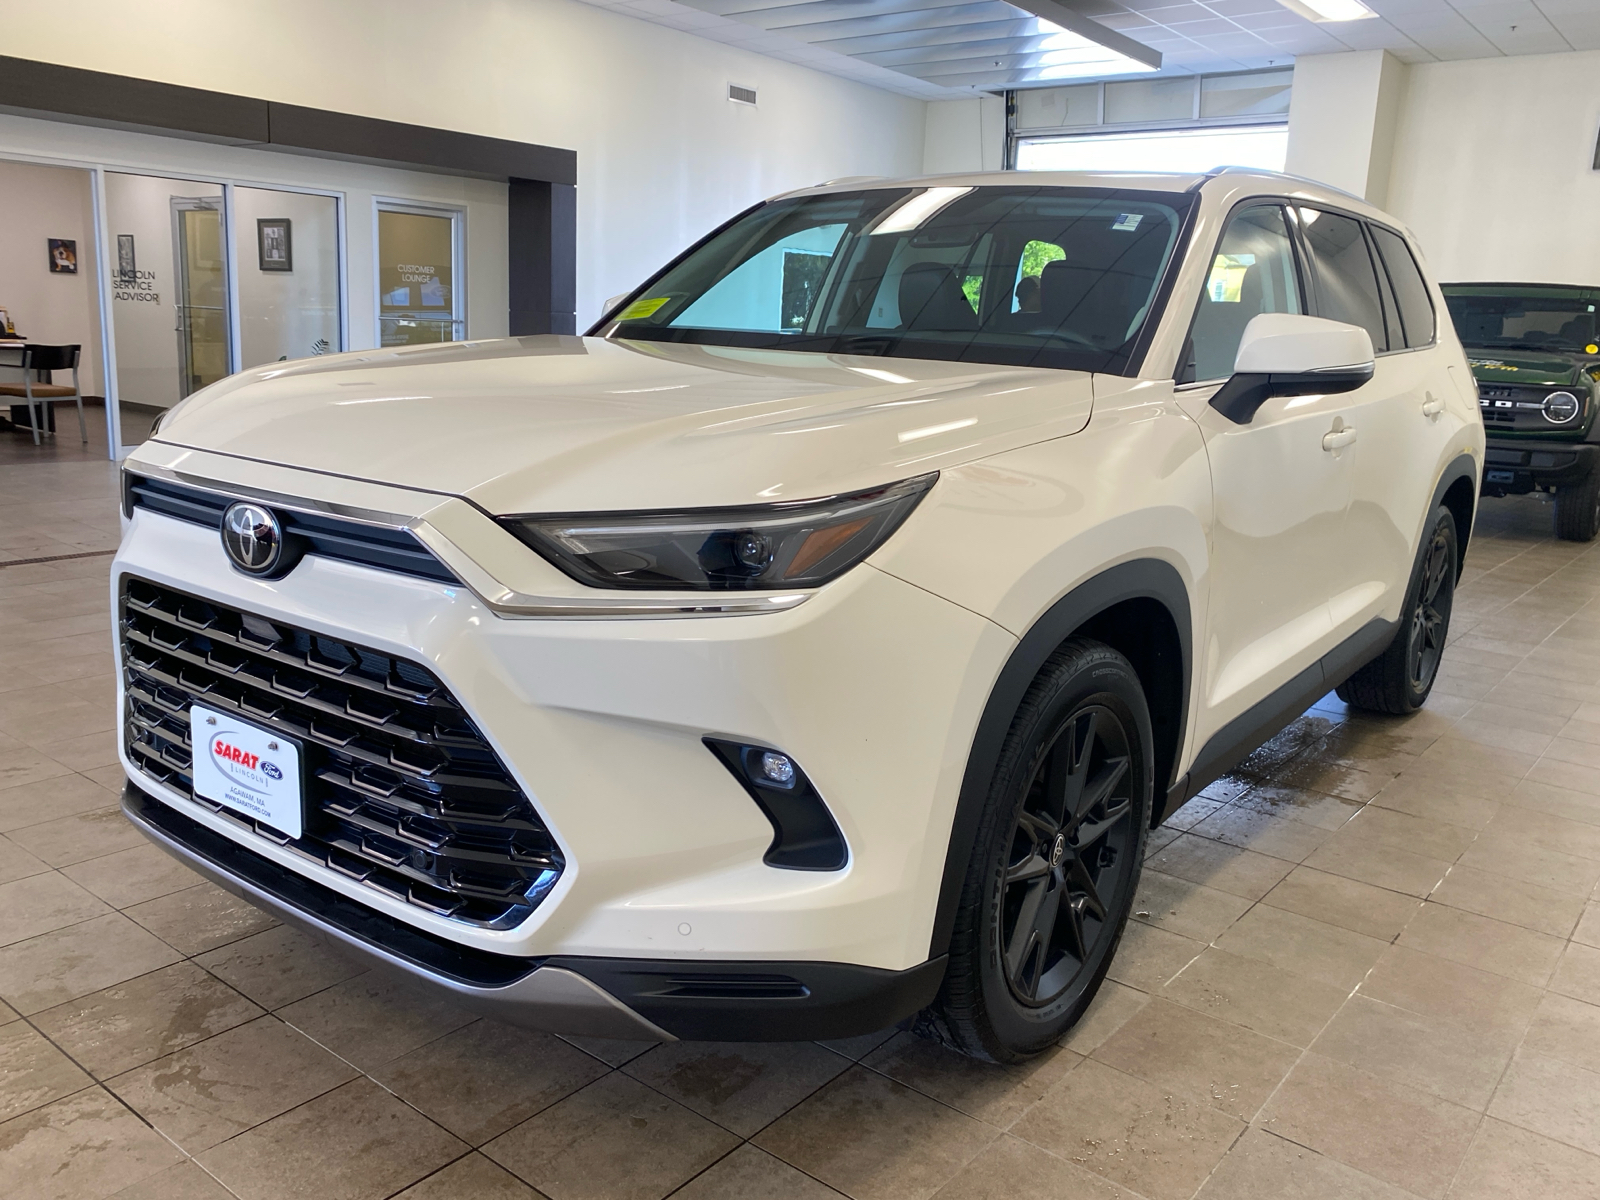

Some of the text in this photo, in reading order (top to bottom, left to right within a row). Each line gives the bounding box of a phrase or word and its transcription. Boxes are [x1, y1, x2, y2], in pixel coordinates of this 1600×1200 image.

[112, 269, 156, 280] LINCOLN
[397, 264, 435, 274] CUSTOMER
[402, 274, 431, 283] LOUNGE
[113, 280, 153, 291] SERVICE
[114, 291, 159, 303] ADVISOR
[214, 740, 260, 771] SARAT
[235, 766, 264, 784] LINCOLN
[262, 762, 282, 779] Ford
[225, 793, 271, 818] WWW.SARATFORD.COM
[256, 797, 266, 808] MA
